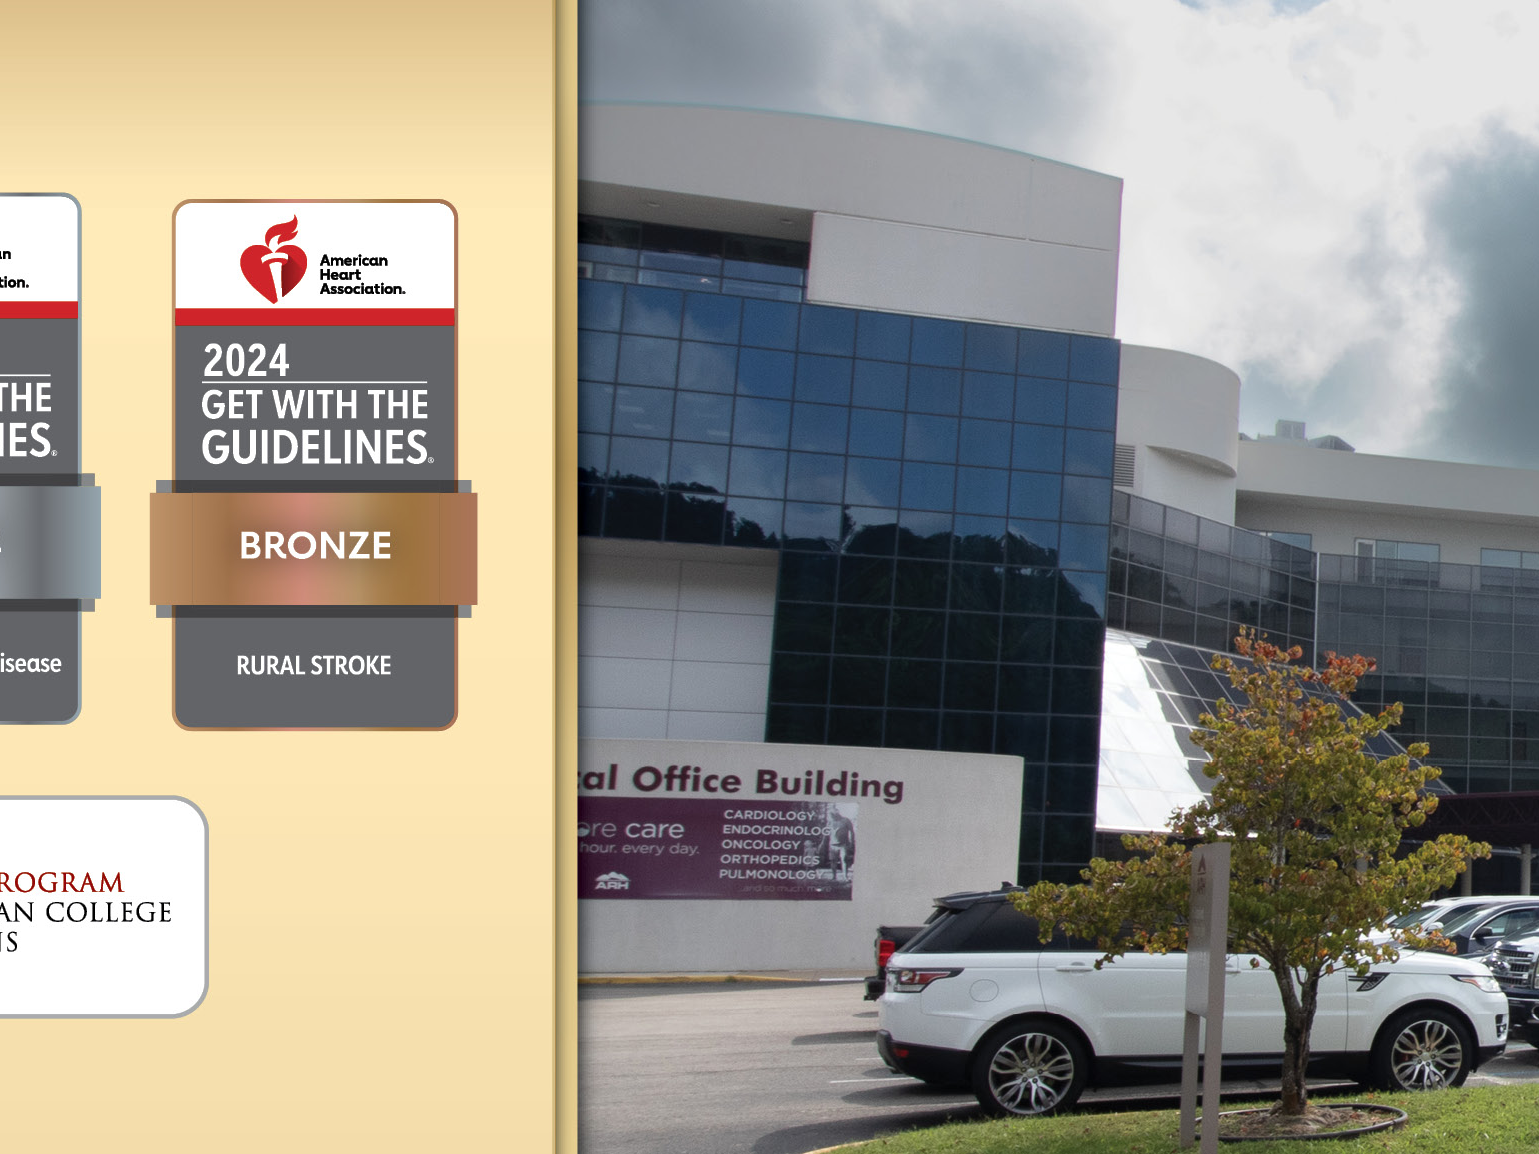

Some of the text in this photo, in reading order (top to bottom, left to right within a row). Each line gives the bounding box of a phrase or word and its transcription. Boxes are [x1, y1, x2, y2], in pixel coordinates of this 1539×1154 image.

[633, 765, 742, 793] Office
[756, 769, 904, 804] Building
[724, 810, 815, 821] CARDIOLOGY
[625, 822, 685, 839] care
[723, 824, 839, 836] ENDOCRINOLOGY
[622, 844, 665, 857] every
[669, 842, 700, 857] day.
[722, 839, 801, 850] ONCOLOGY
[720, 854, 820, 865] ORTHOPEDICS
[719, 869, 824, 880] PULMONOLOGY
[595, 881, 629, 890] ARH
